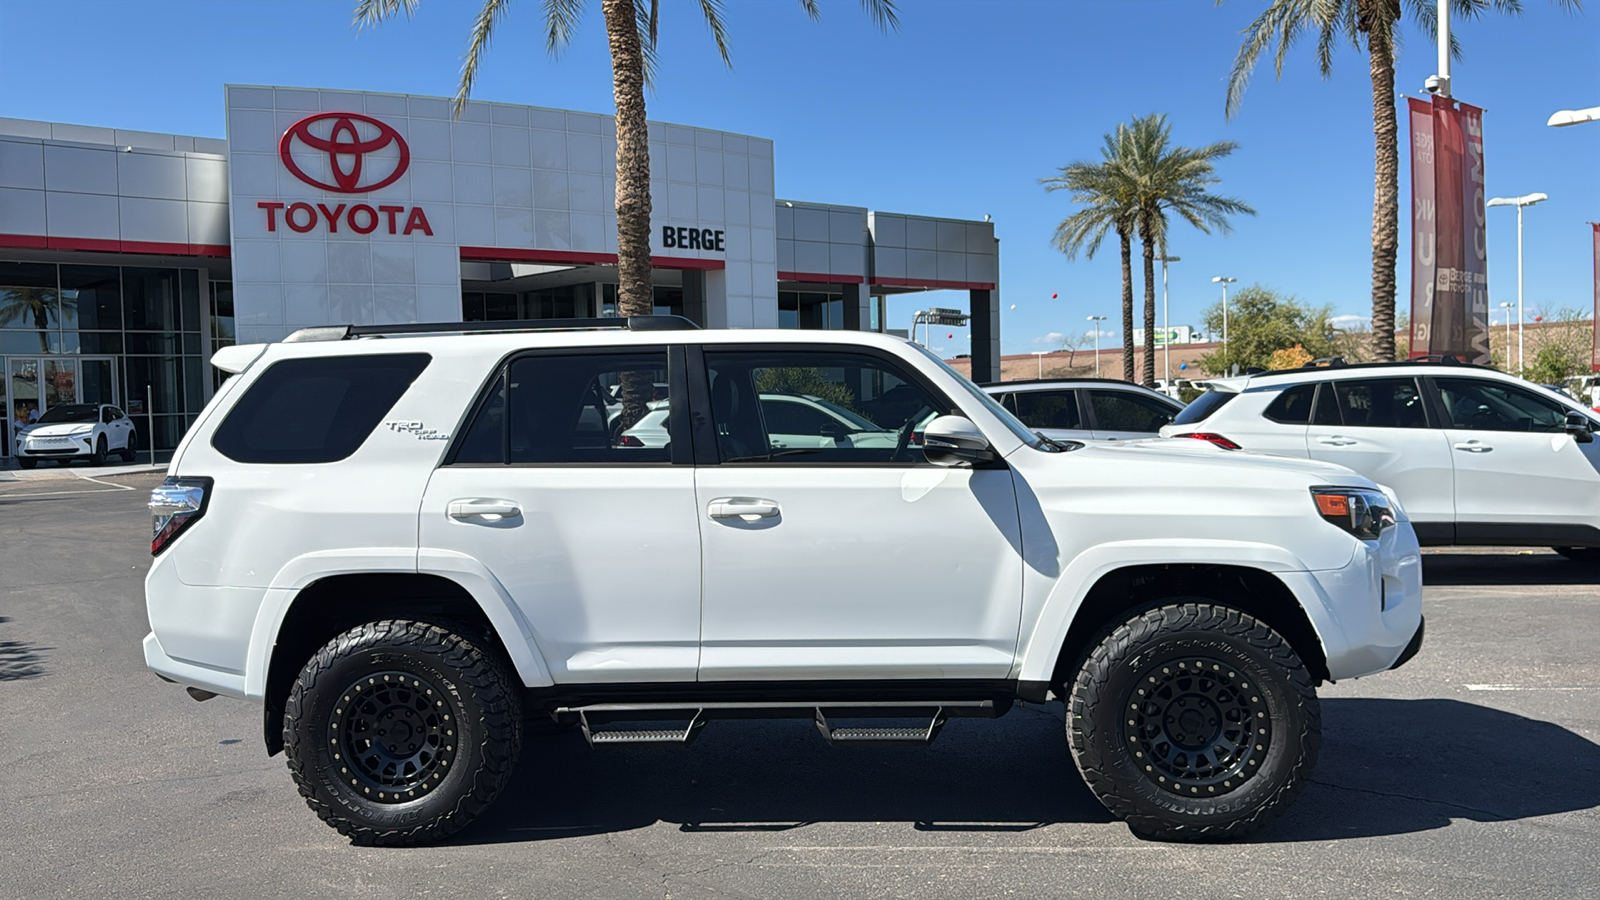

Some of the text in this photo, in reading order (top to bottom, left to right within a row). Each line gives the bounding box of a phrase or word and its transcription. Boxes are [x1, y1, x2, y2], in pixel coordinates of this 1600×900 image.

[257, 202, 434, 236] TOYOTA
[663, 226, 725, 252] BERGE
[1450, 284, 1472, 293] TOYOTA
[385, 420, 423, 433] TRD
